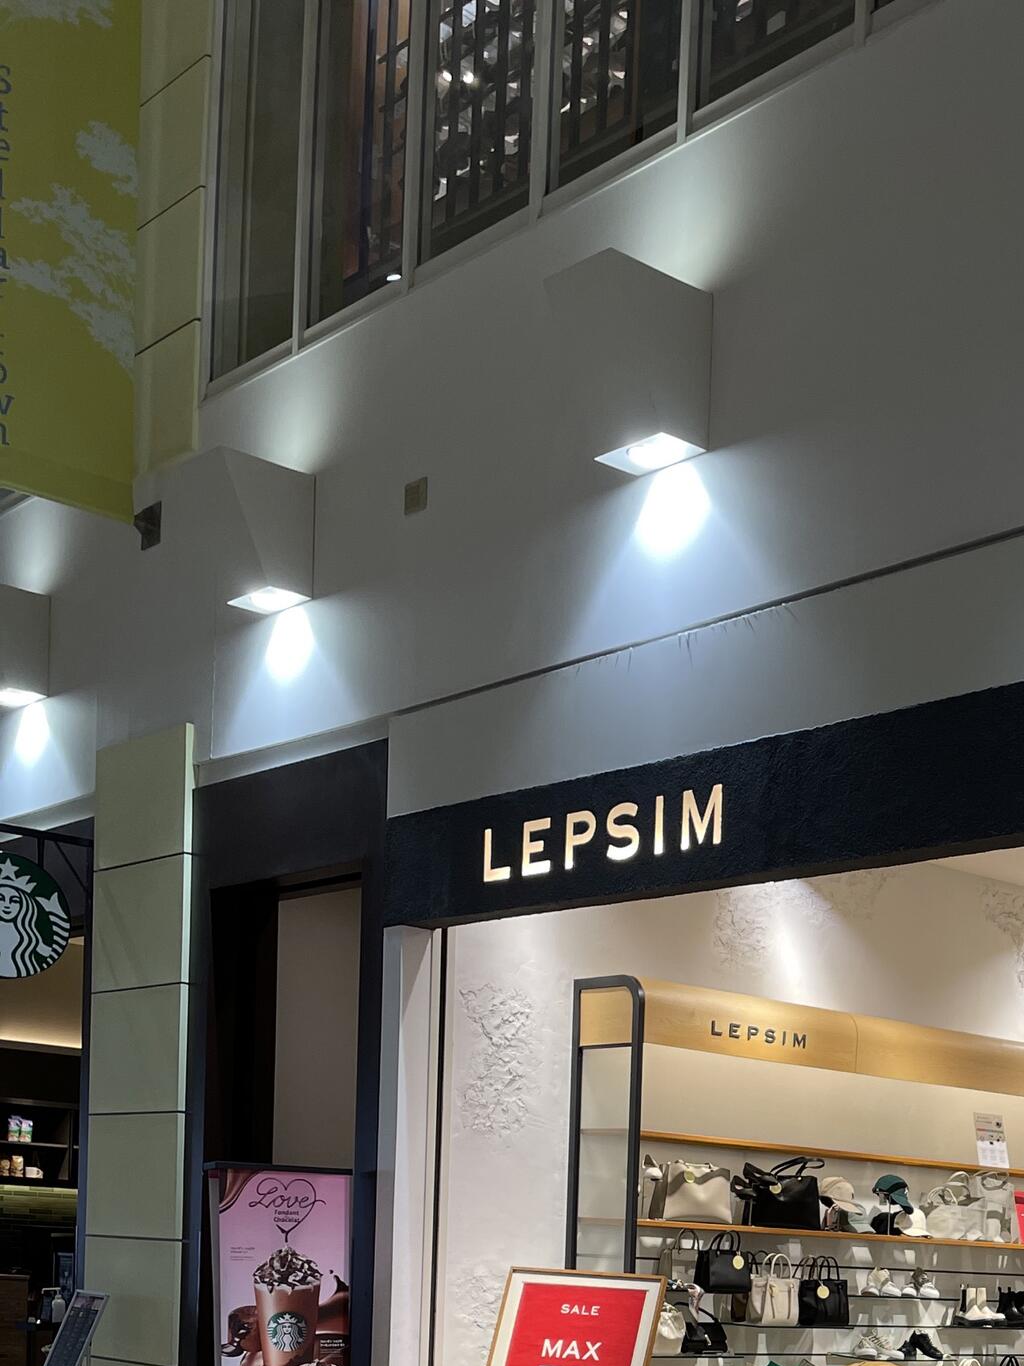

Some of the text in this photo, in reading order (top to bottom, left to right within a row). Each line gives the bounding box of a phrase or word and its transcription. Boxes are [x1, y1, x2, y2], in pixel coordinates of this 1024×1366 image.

[482, 783, 723, 883] LEPSIM
[710, 1019, 808, 1050] LEPSIM
[248, 1182, 322, 1209] Love
[560, 1303, 601, 1316] SALE
[541, 1339, 602, 1361] MAX
